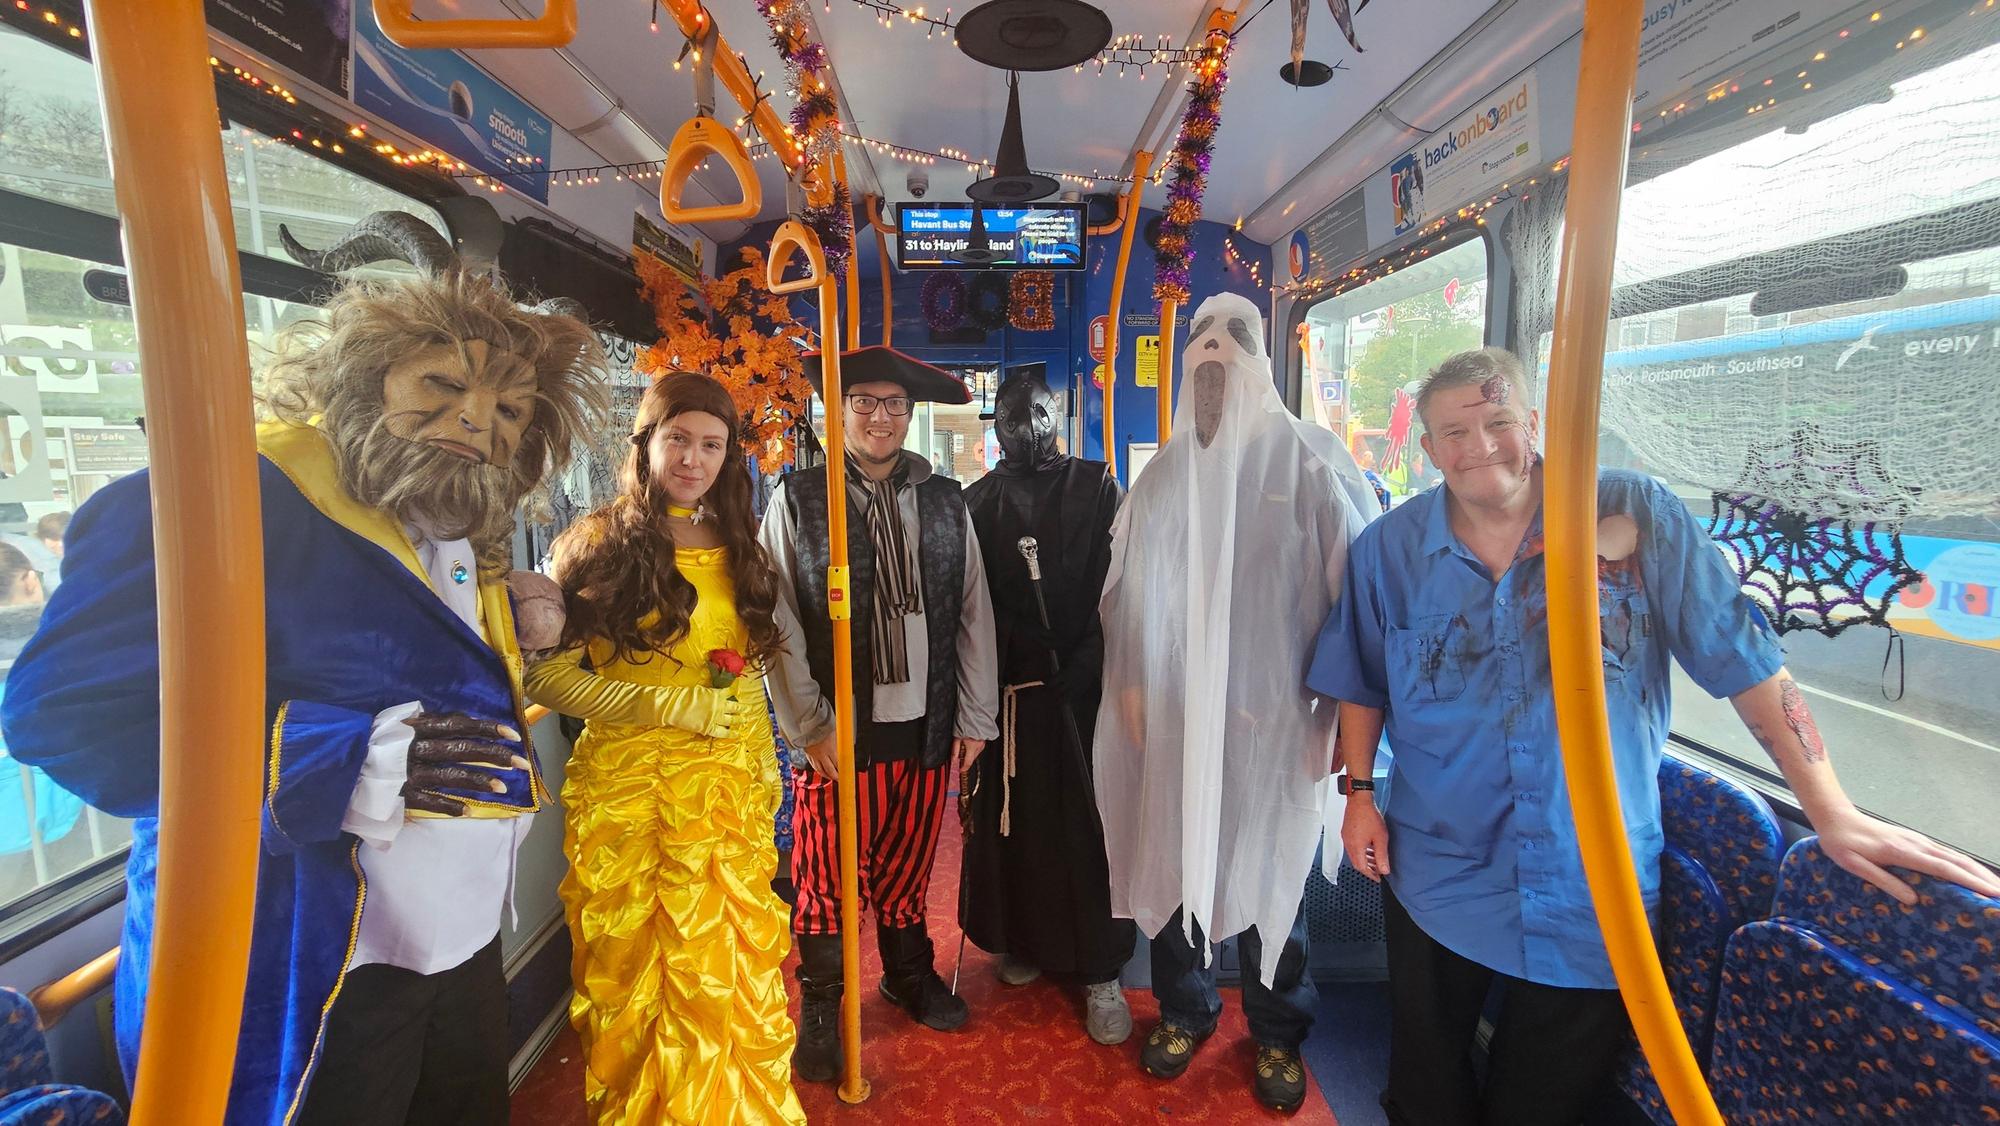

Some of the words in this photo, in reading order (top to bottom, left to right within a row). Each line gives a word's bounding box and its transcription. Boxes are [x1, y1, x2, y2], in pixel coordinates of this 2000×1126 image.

[488, 114, 528, 148] smooth
[911, 210, 924, 218] This
[925, 211, 938, 219] stop
[911, 220, 941, 229] Havant
[942, 220, 957, 229] Bus
[959, 220, 989, 229] Stan
[905, 239, 918, 250] 31
[920, 239, 933, 250] to
[934, 239, 969, 252] Haylin
[987, 239, 1014, 250] land
[102, 286, 129, 300] BRE
[1904, 334, 1980, 356] every
[1641, 363, 1716, 384] Portsmouth
[1726, 353, 1805, 375] Southsea
[1323, 386, 1336, 400] D
[73, 432, 98, 442] Stay
[101, 432, 126, 441] Safe
